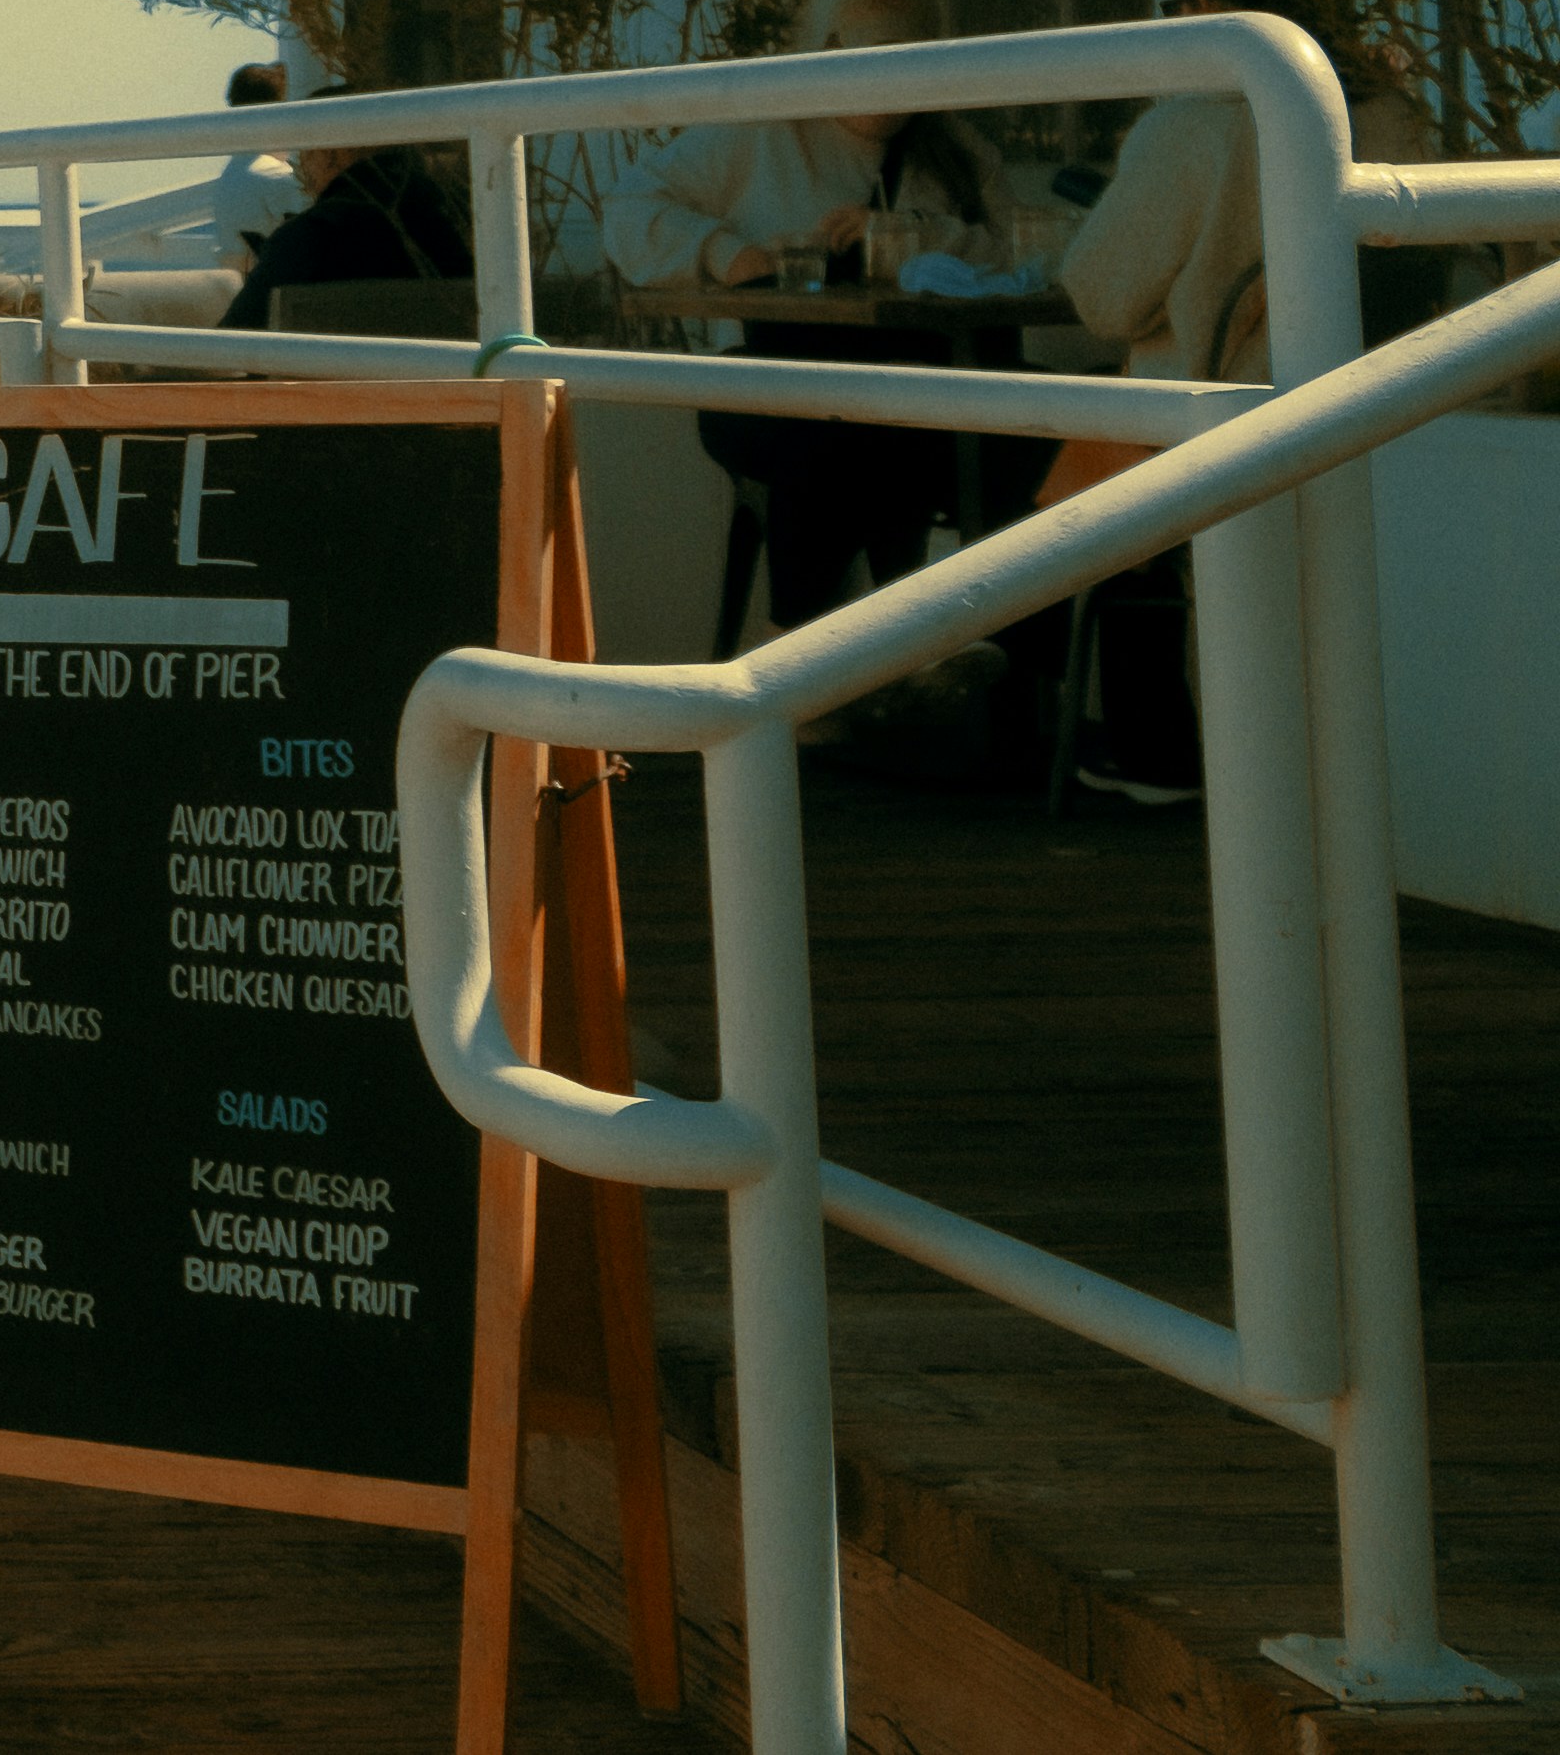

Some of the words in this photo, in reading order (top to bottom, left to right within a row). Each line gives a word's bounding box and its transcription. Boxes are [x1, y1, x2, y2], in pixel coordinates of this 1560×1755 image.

[60, 650, 131, 698] END
[144, 651, 185, 698] OF
[196, 652, 285, 698] PIER
[261, 737, 354, 778] BITES
[169, 804, 287, 848] AVOCADO
[298, 810, 348, 850] LOX
[169, 853, 337, 905] CALIFLOWER
[171, 907, 245, 953] CLAM
[259, 913, 404, 966] CHOWDER
[170, 964, 293, 1010] CHICKEN
[218, 1091, 327, 1135] SALADS
[192, 1158, 264, 1198] KALE
[273, 1166, 394, 1212] CAESAR
[191, 1209, 297, 1259] VEGAN
[304, 1221, 389, 1266] CHOP
[185, 1257, 321, 1307] BURRATA
[333, 1275, 419, 1319] FRUIT
